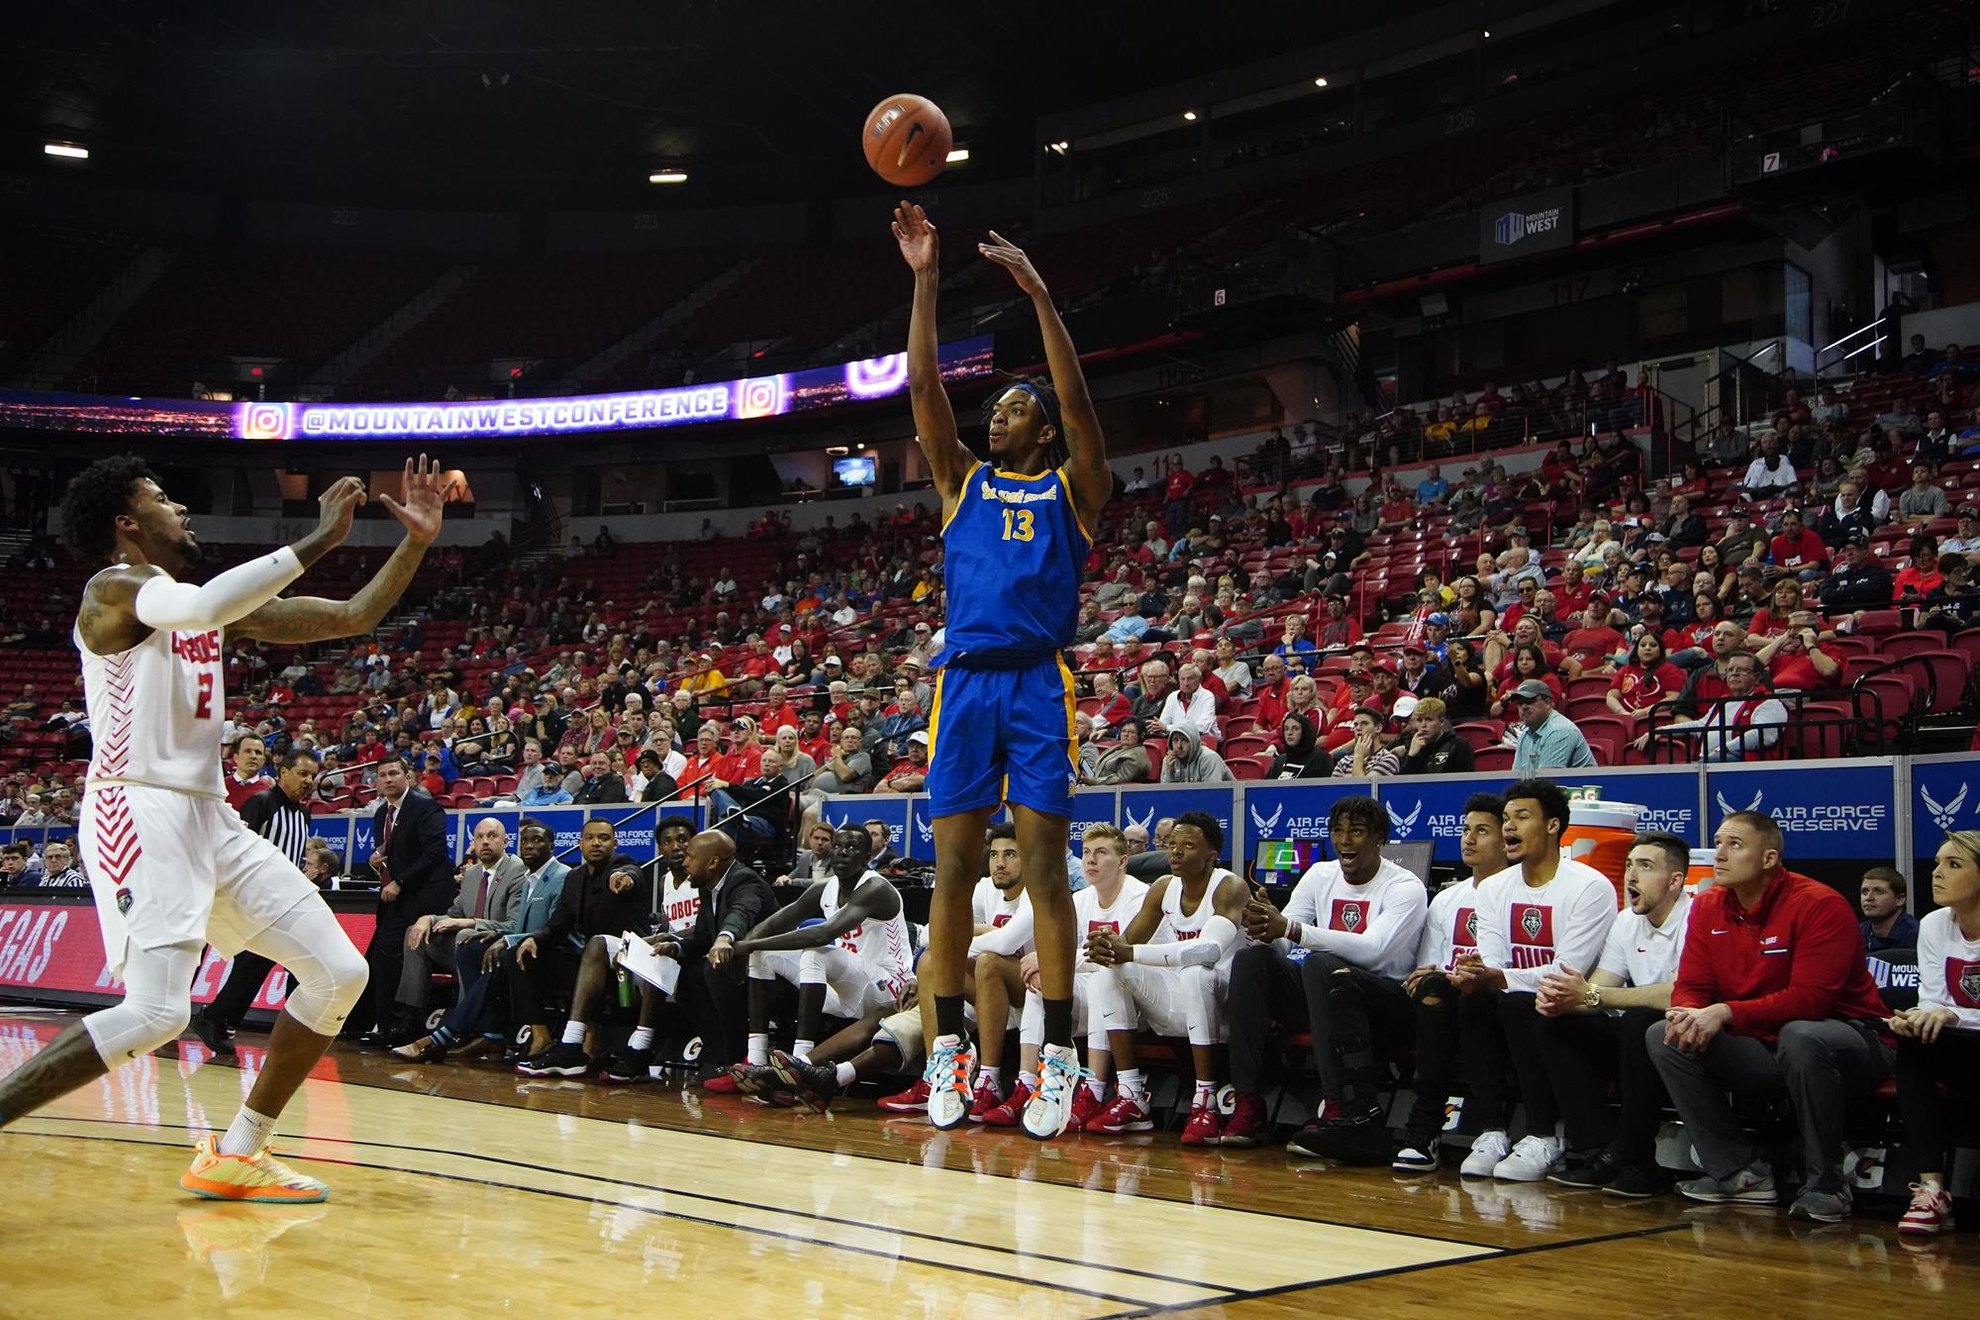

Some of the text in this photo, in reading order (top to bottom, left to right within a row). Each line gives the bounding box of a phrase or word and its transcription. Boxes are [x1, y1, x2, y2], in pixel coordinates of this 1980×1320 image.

[633, 213, 658, 229] 223
[1525, 208, 1559, 222] MOUNTAIN
[1526, 216, 1559, 234] WEST
[305, 389, 725, 431] @MOUNTAINWESTCONFERENCE
[1002, 508, 1035, 542] 13
[195, 672, 213, 719] 2
[1639, 809, 1692, 822] ORCE
[1770, 805, 1886, 818] AIR FORCE
[1286, 817, 1312, 827] AIR
[1427, 814, 1456, 826] AIR
[1777, 818, 1878, 832] RESERVE
[630, 830, 653, 838] FORCE
[1290, 827, 1329, 838] RESE
[1634, 822, 1685, 833] ERVE
[666, 896, 700, 921] LOBOS
[1891, 964, 1919, 974] MOUN
[1891, 973, 1921, 987] WE
[425, 1009, 446, 1030] G
[516, 1024, 532, 1045] G
[683, 1036, 703, 1061] G
